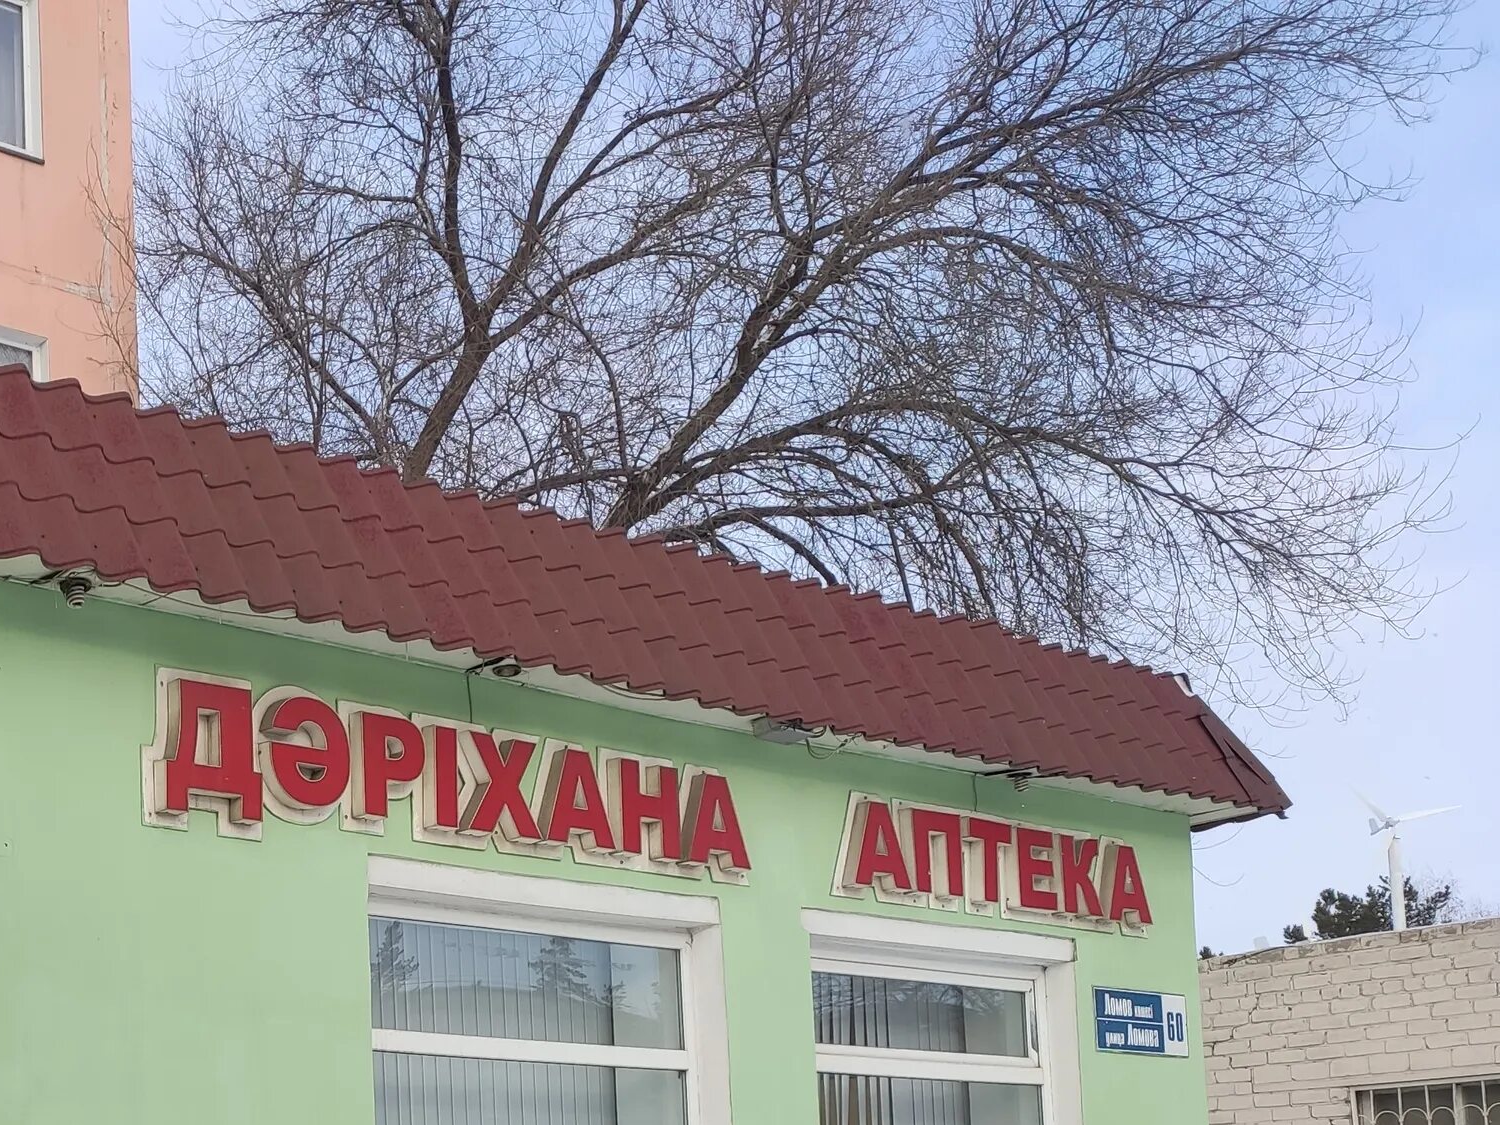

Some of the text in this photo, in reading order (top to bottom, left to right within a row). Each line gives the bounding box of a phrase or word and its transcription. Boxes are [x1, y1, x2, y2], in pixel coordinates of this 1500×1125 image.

[156, 678, 751, 872] ДӘРІХАНА
[846, 800, 1154, 926] АПТЕКА
[1104, 993, 1133, 1016] Ломов
[1105, 1023, 1160, 1047] улица Ломова
[1167, 1012, 1184, 1042] 60
